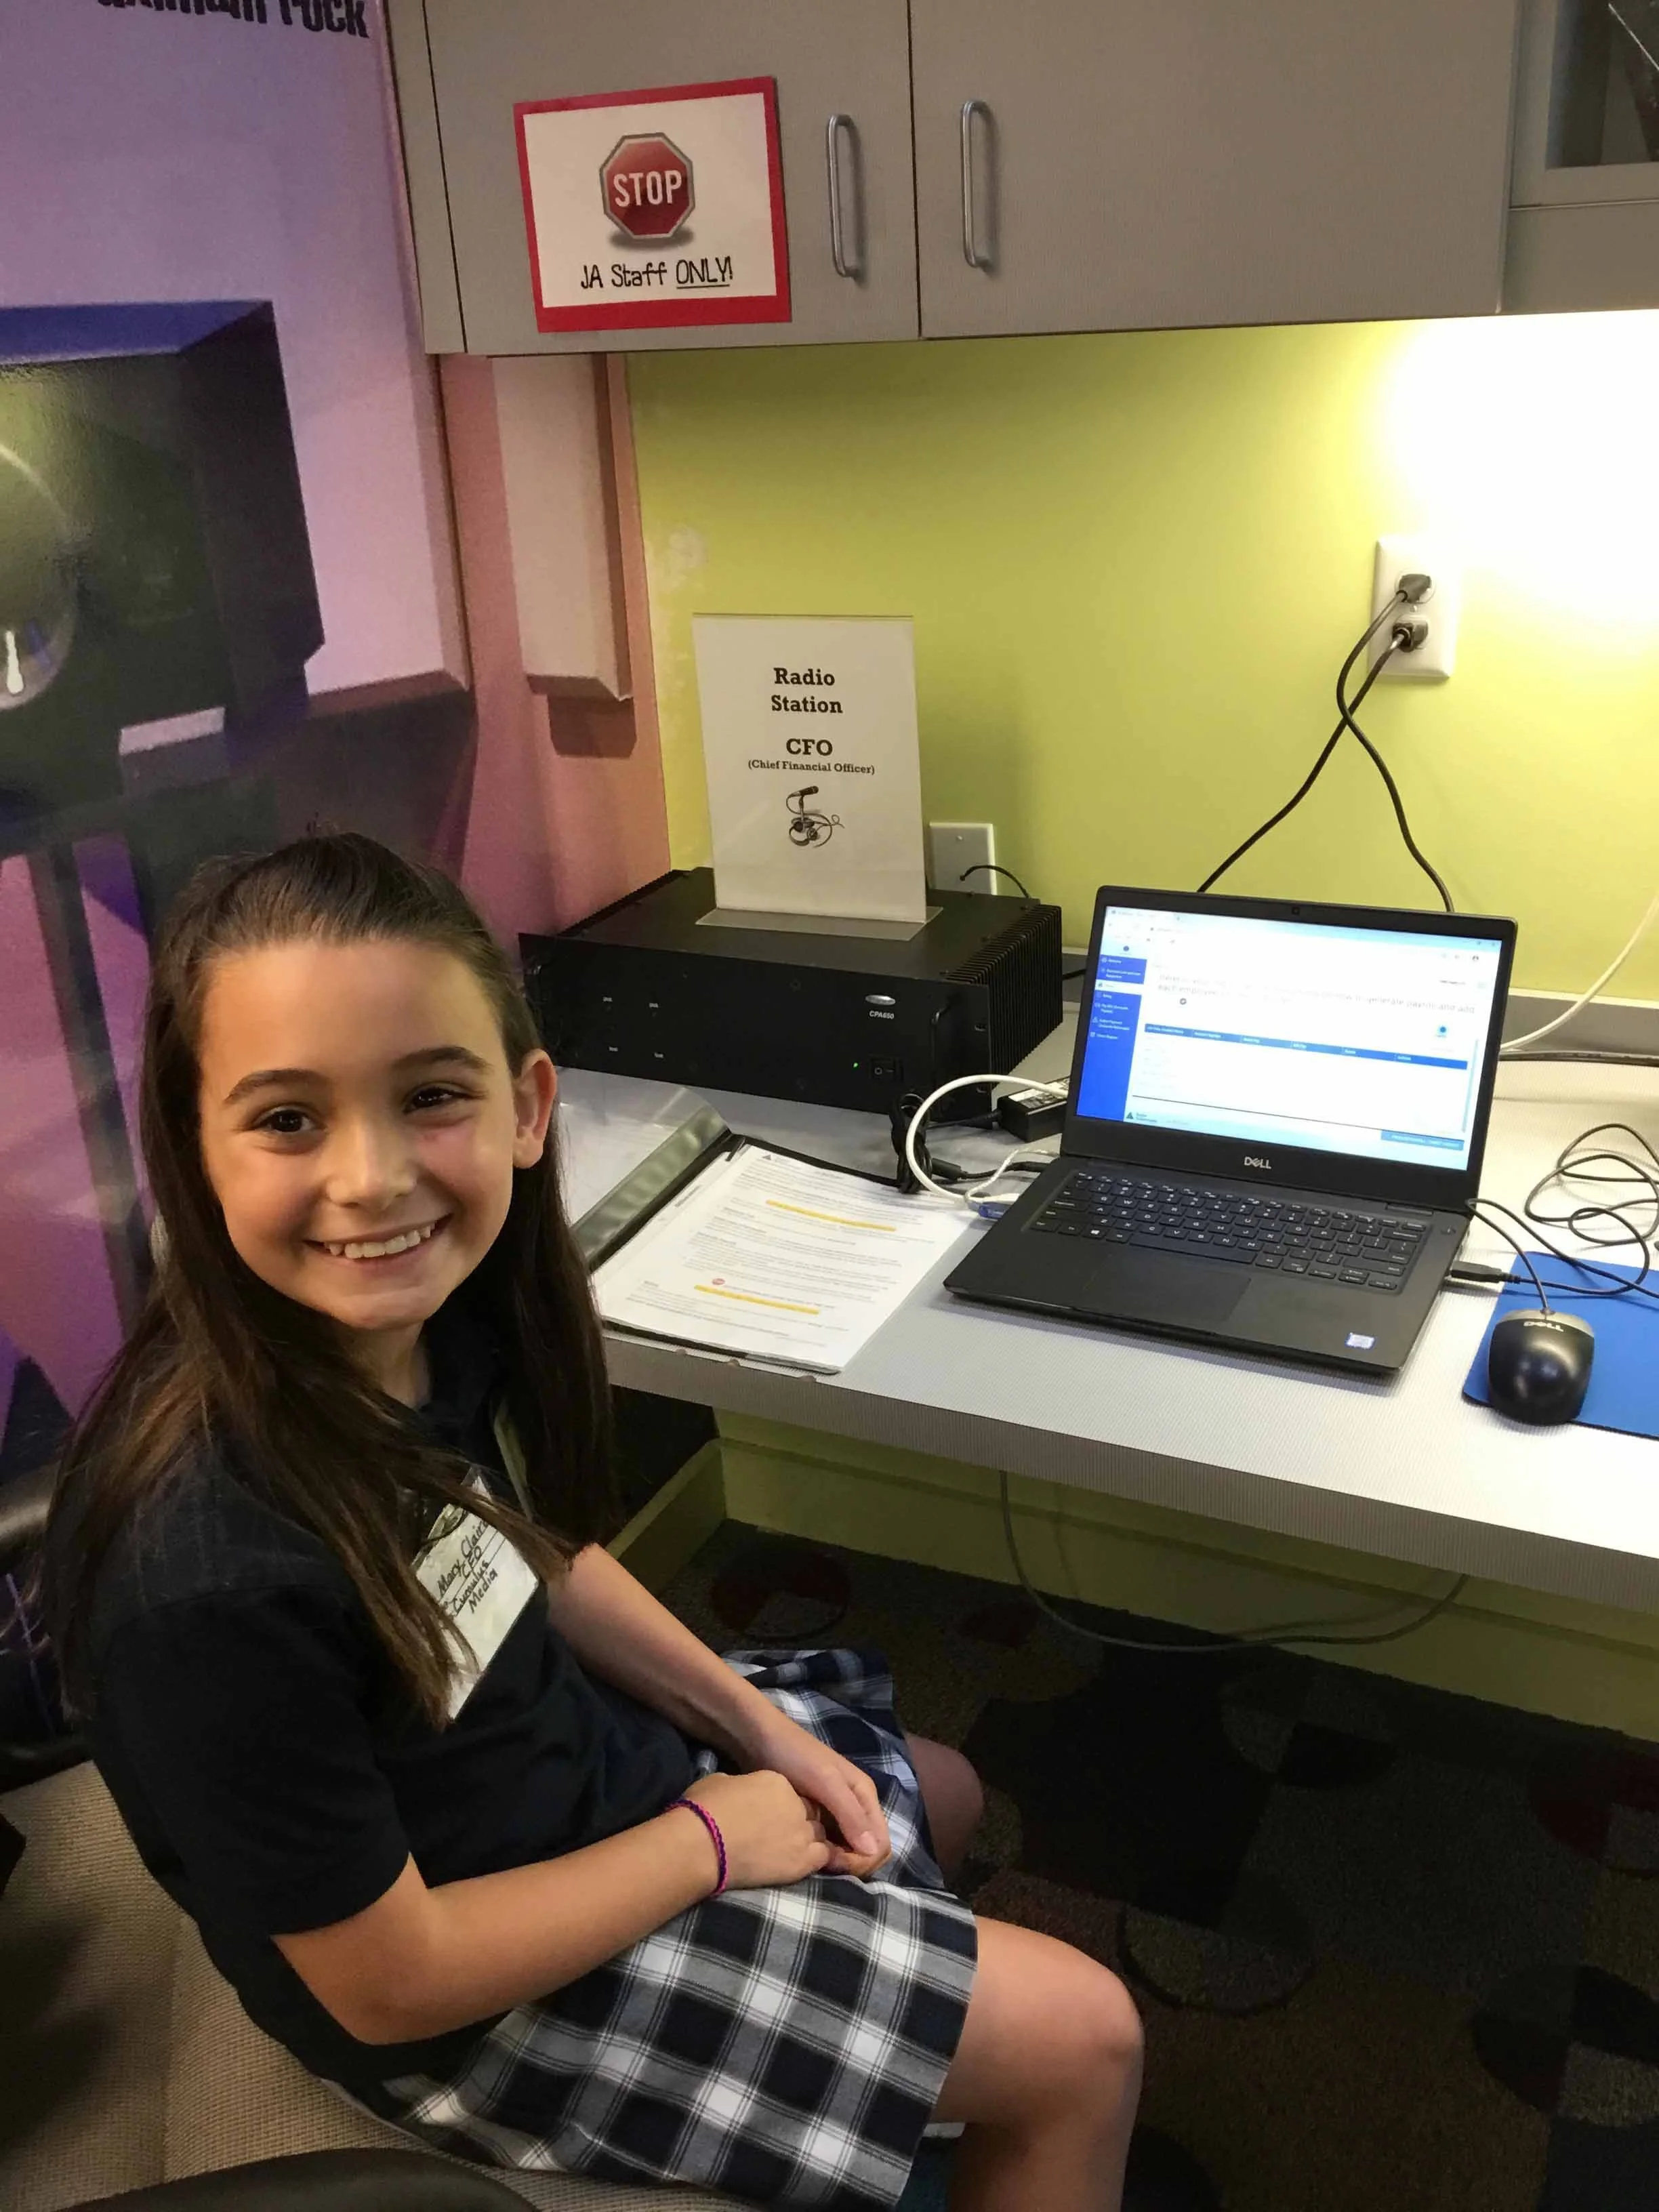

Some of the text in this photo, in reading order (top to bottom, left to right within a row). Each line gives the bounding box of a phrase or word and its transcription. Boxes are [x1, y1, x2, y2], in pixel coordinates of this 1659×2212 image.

[613, 170, 682, 207] STOP
[581, 256, 733, 289] JA Staff ONLY!
[774, 668, 836, 686] Radio
[771, 695, 843, 714] Station
[786, 739, 833, 756] CFO
[748, 760, 875, 775] (Chief Financial Officer)
[1244, 1156, 1271, 1170] DELL
[437, 1559, 462, 1598] Mary
[468, 1568, 498, 1614] Media
